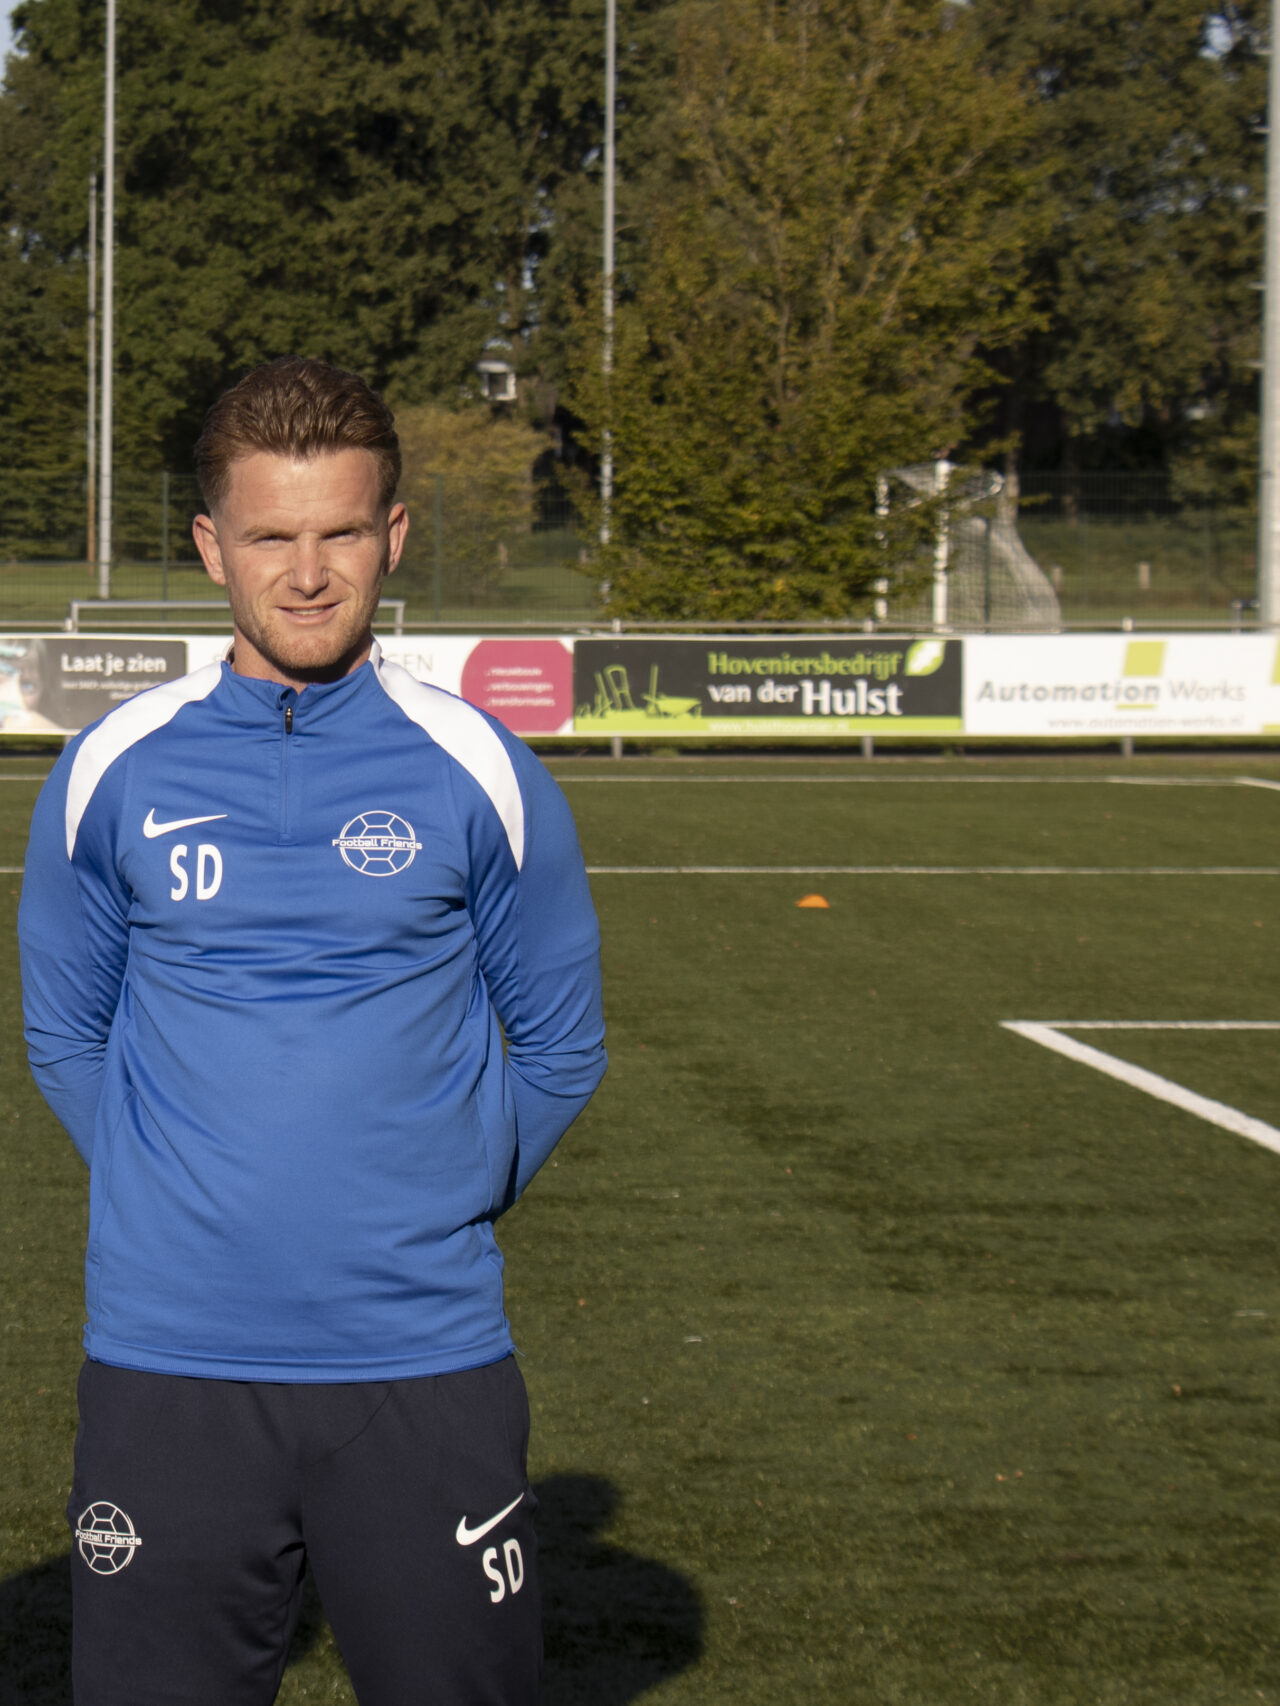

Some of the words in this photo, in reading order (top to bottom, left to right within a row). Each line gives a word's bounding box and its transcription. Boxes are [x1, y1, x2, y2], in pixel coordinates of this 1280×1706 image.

[61, 653, 104, 672] Laat
[104, 652, 125, 676] je
[126, 652, 167, 673] zien
[708, 652, 903, 680] Hoveniersbedrijf
[707, 684, 751, 703] van
[757, 679, 799, 703] der
[799, 679, 904, 716] Hulst
[976, 681, 1161, 703] Automation
[1167, 681, 1247, 702] Works
[331, 838, 378, 848] Football
[380, 839, 423, 850] Friends
[170, 843, 223, 902] SD
[75, 1529, 103, 1543] Football
[104, 1534, 142, 1546] Friends
[482, 1538, 524, 1603] SD
